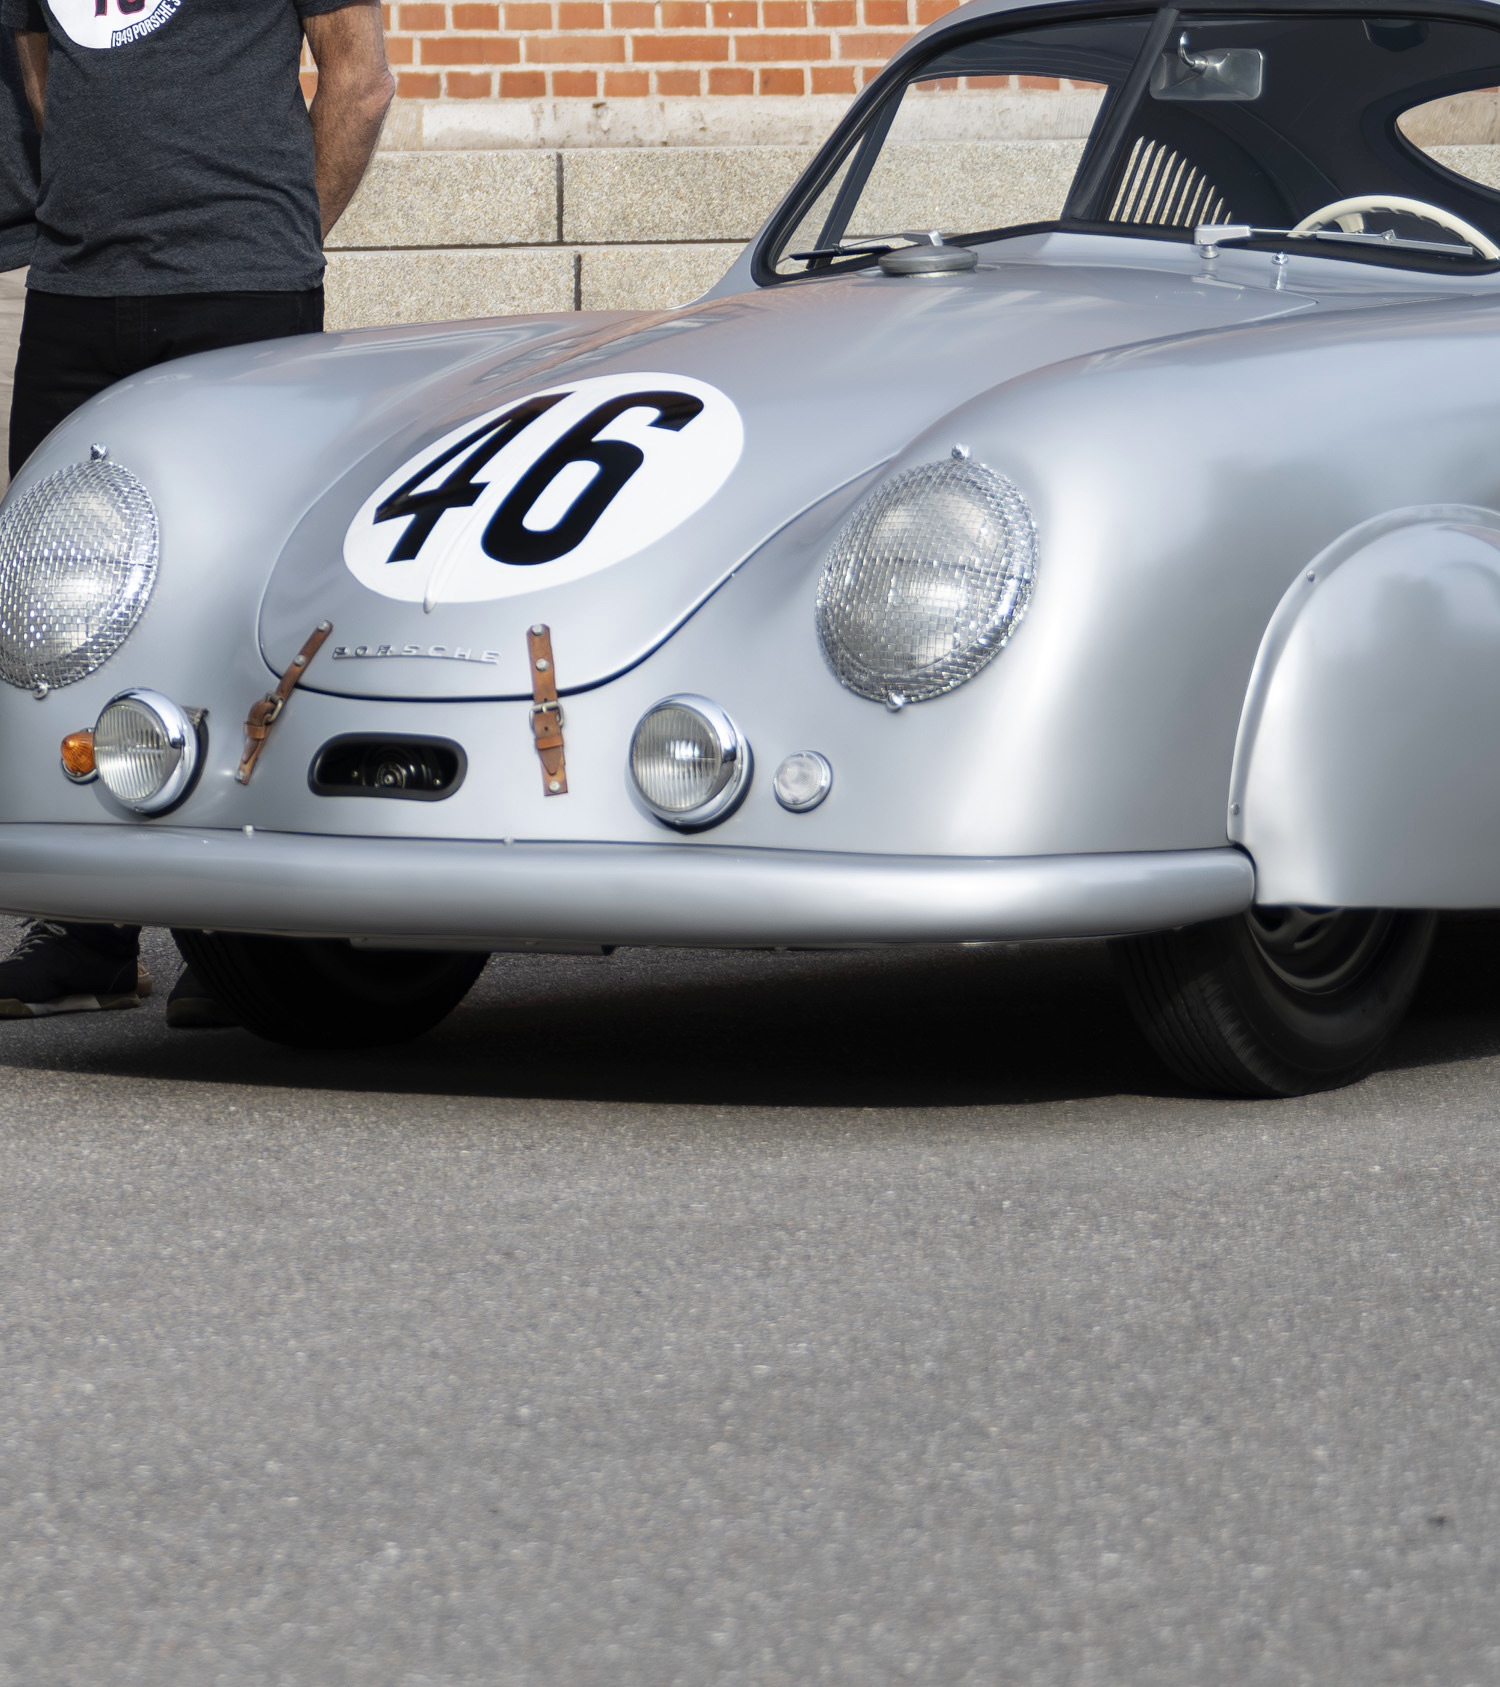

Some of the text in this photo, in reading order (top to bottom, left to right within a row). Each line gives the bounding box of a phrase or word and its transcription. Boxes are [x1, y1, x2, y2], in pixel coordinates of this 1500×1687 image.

[112, 28, 134, 47] 1949
[133, 2, 176, 39] PORSCHE
[373, 390, 704, 565] 46
[332, 644, 502, 665] PORSCHE
